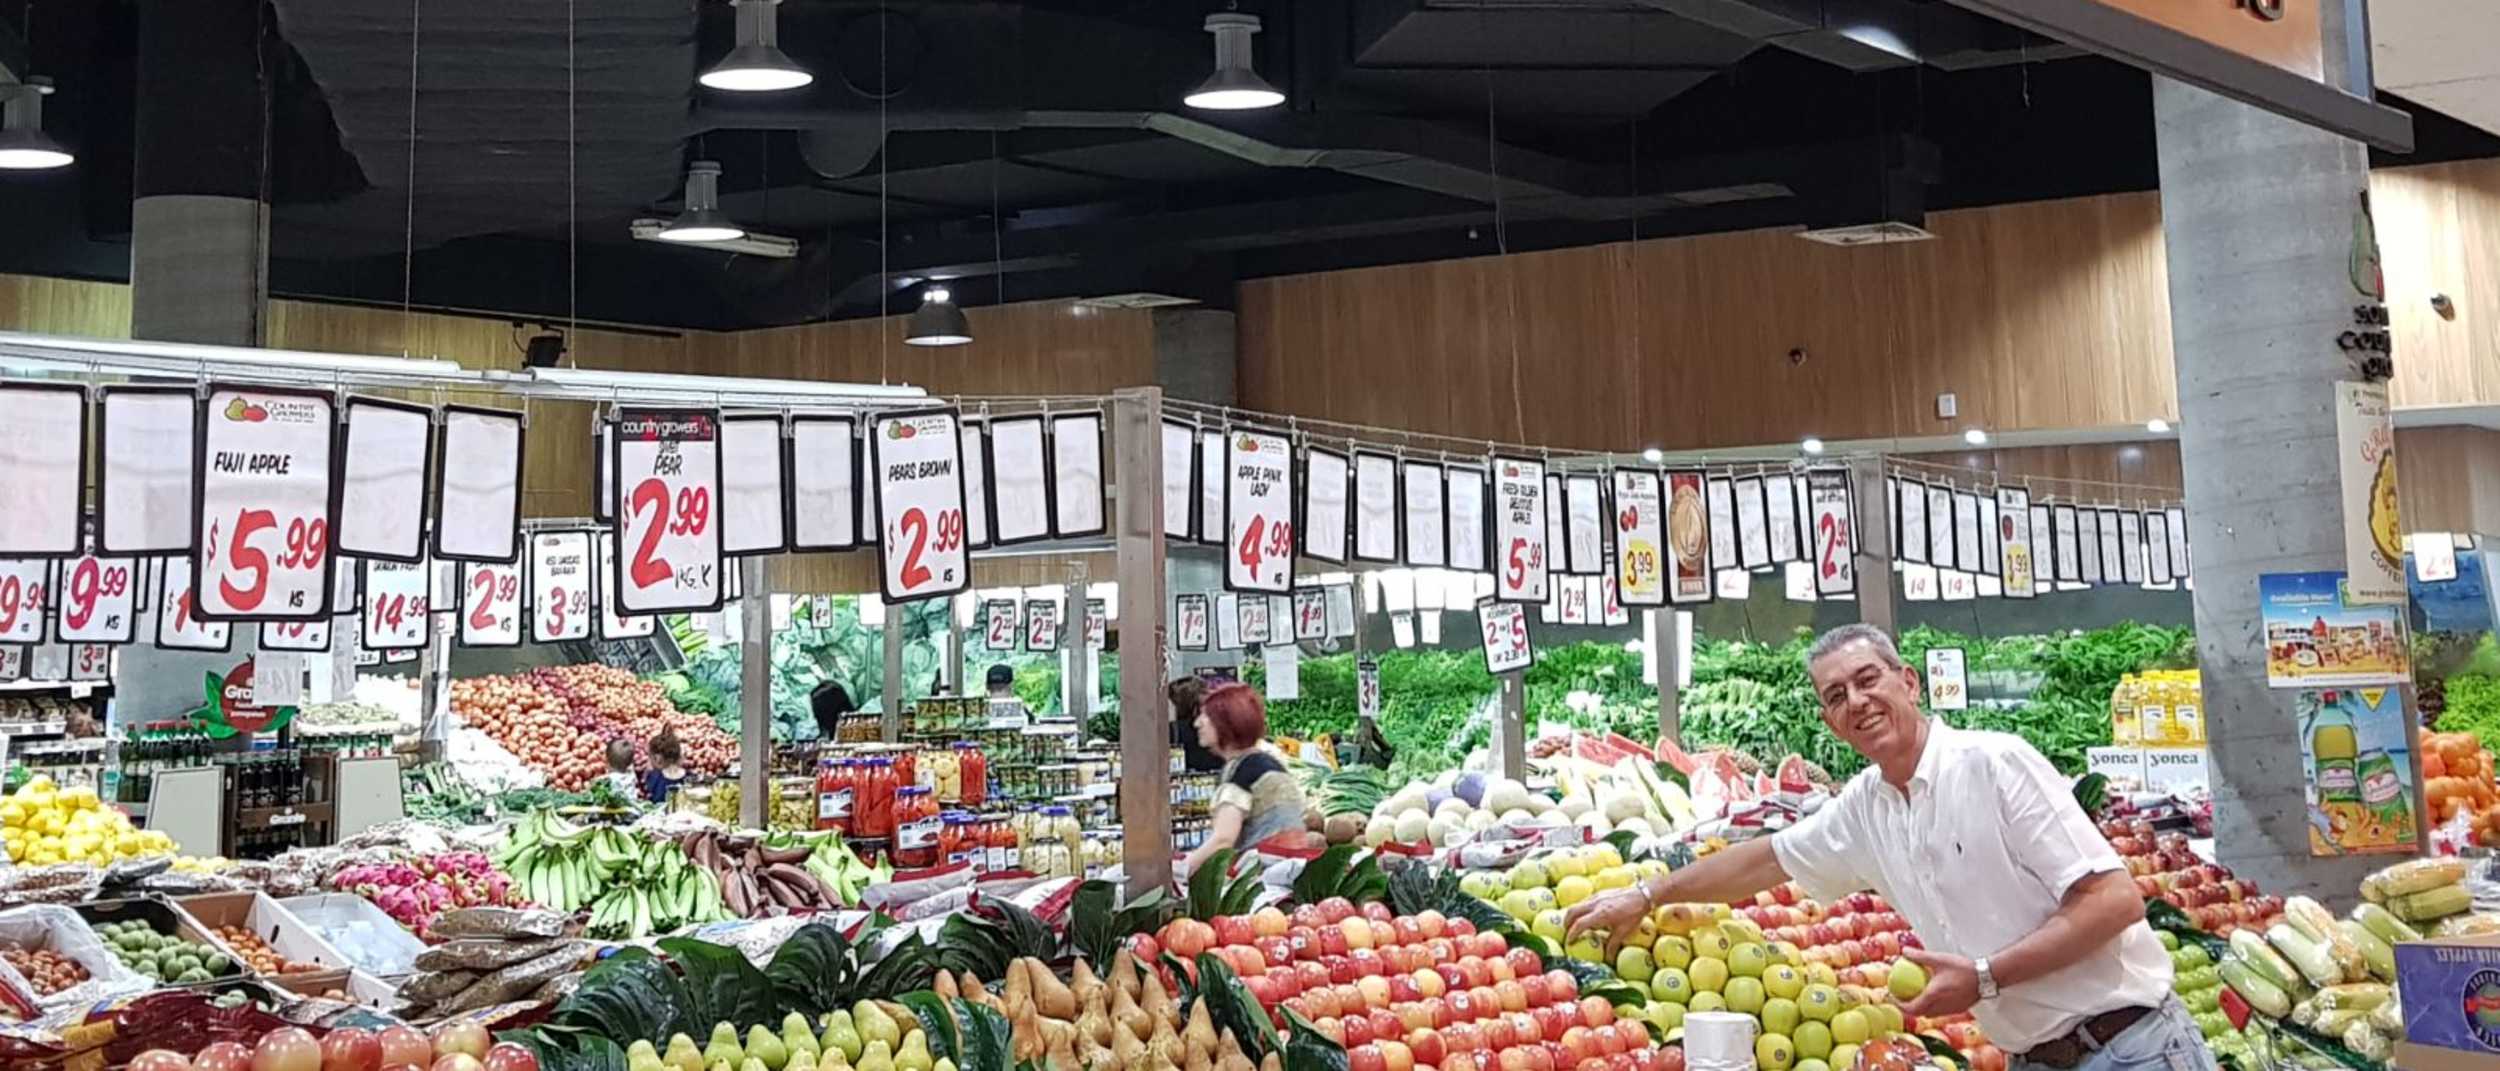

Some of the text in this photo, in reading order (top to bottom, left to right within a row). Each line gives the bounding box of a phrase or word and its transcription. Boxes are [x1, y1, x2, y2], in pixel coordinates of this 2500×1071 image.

[214, 452, 246, 473] FUJI
[248, 453, 292, 475] APPLE
[654, 454, 683, 475] PEAR
[888, 461, 917, 482] PEARS
[918, 458, 953, 479] BROWN
[1238, 465, 1262, 481] APPLE
[2091, 753, 2139, 767] yonca
[2150, 754, 2199, 768] yonca
